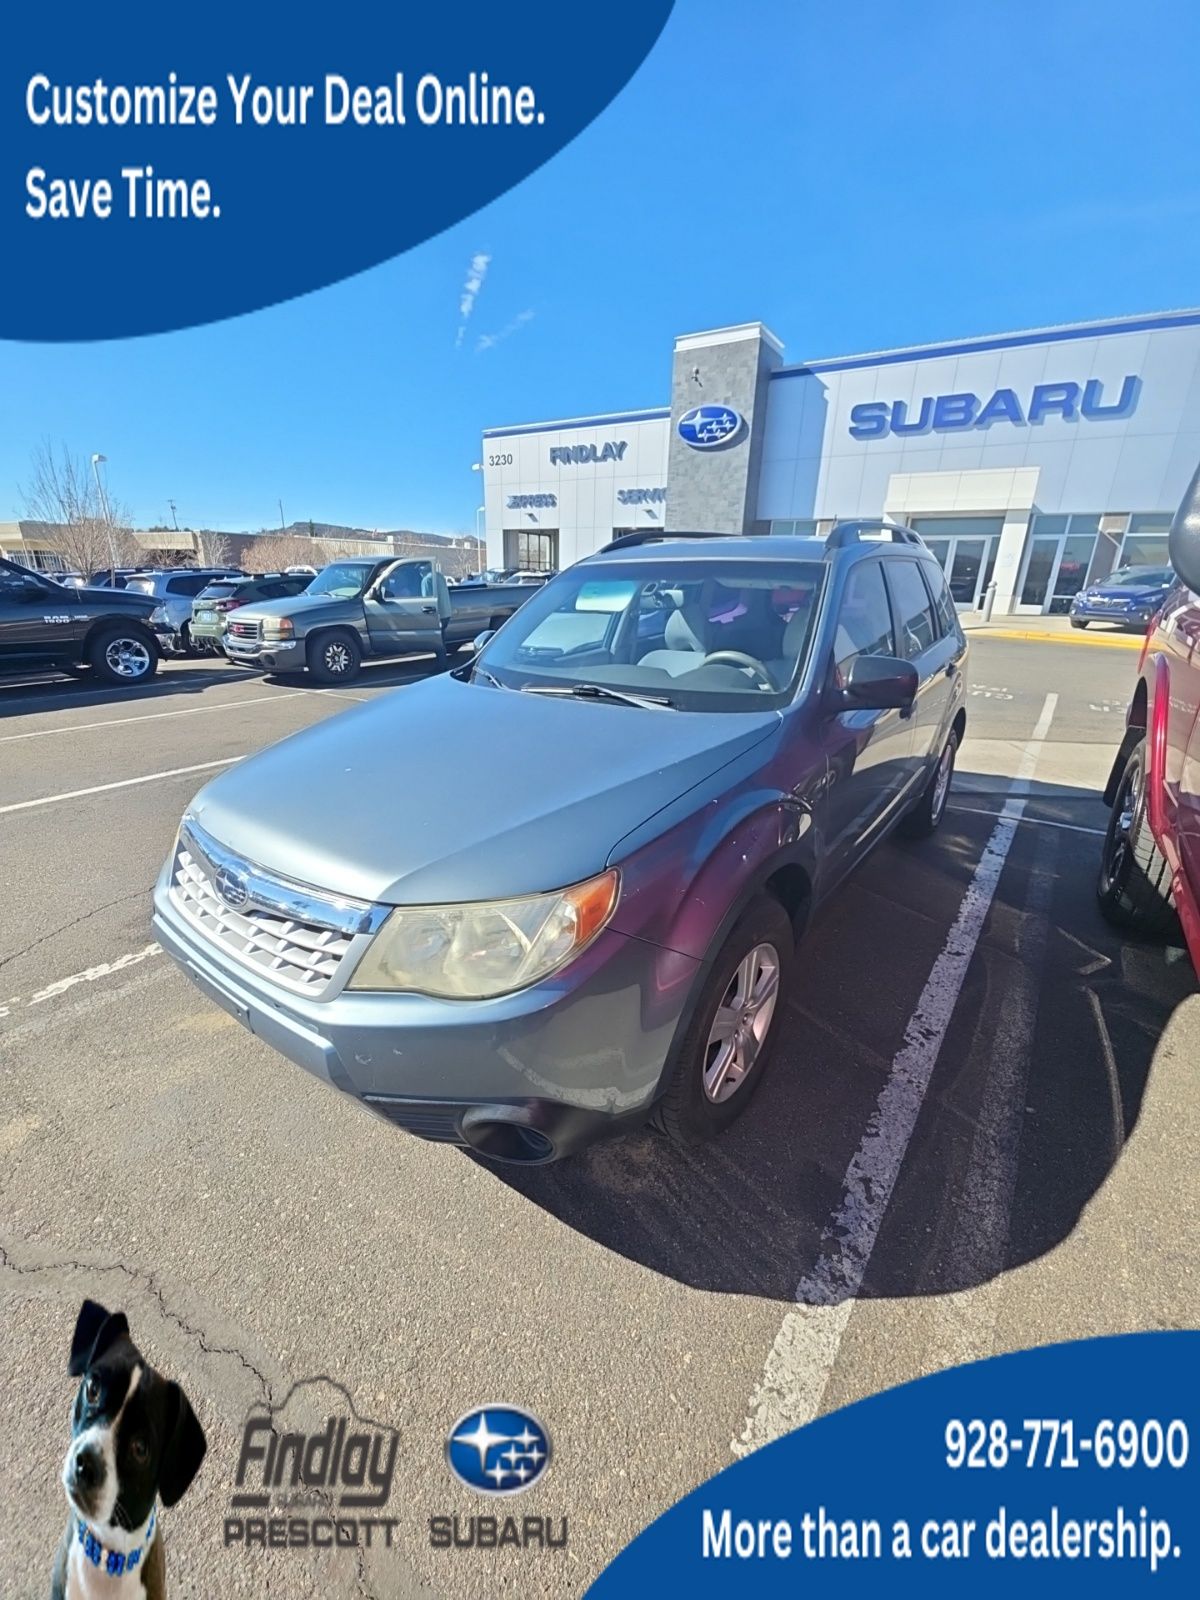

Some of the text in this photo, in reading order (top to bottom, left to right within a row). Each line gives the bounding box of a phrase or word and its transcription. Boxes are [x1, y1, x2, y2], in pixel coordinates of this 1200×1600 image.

[849, 375, 1140, 439] SUBARU
[489, 454, 513, 466] 3230
[549, 440, 628, 465] FINDLAY
